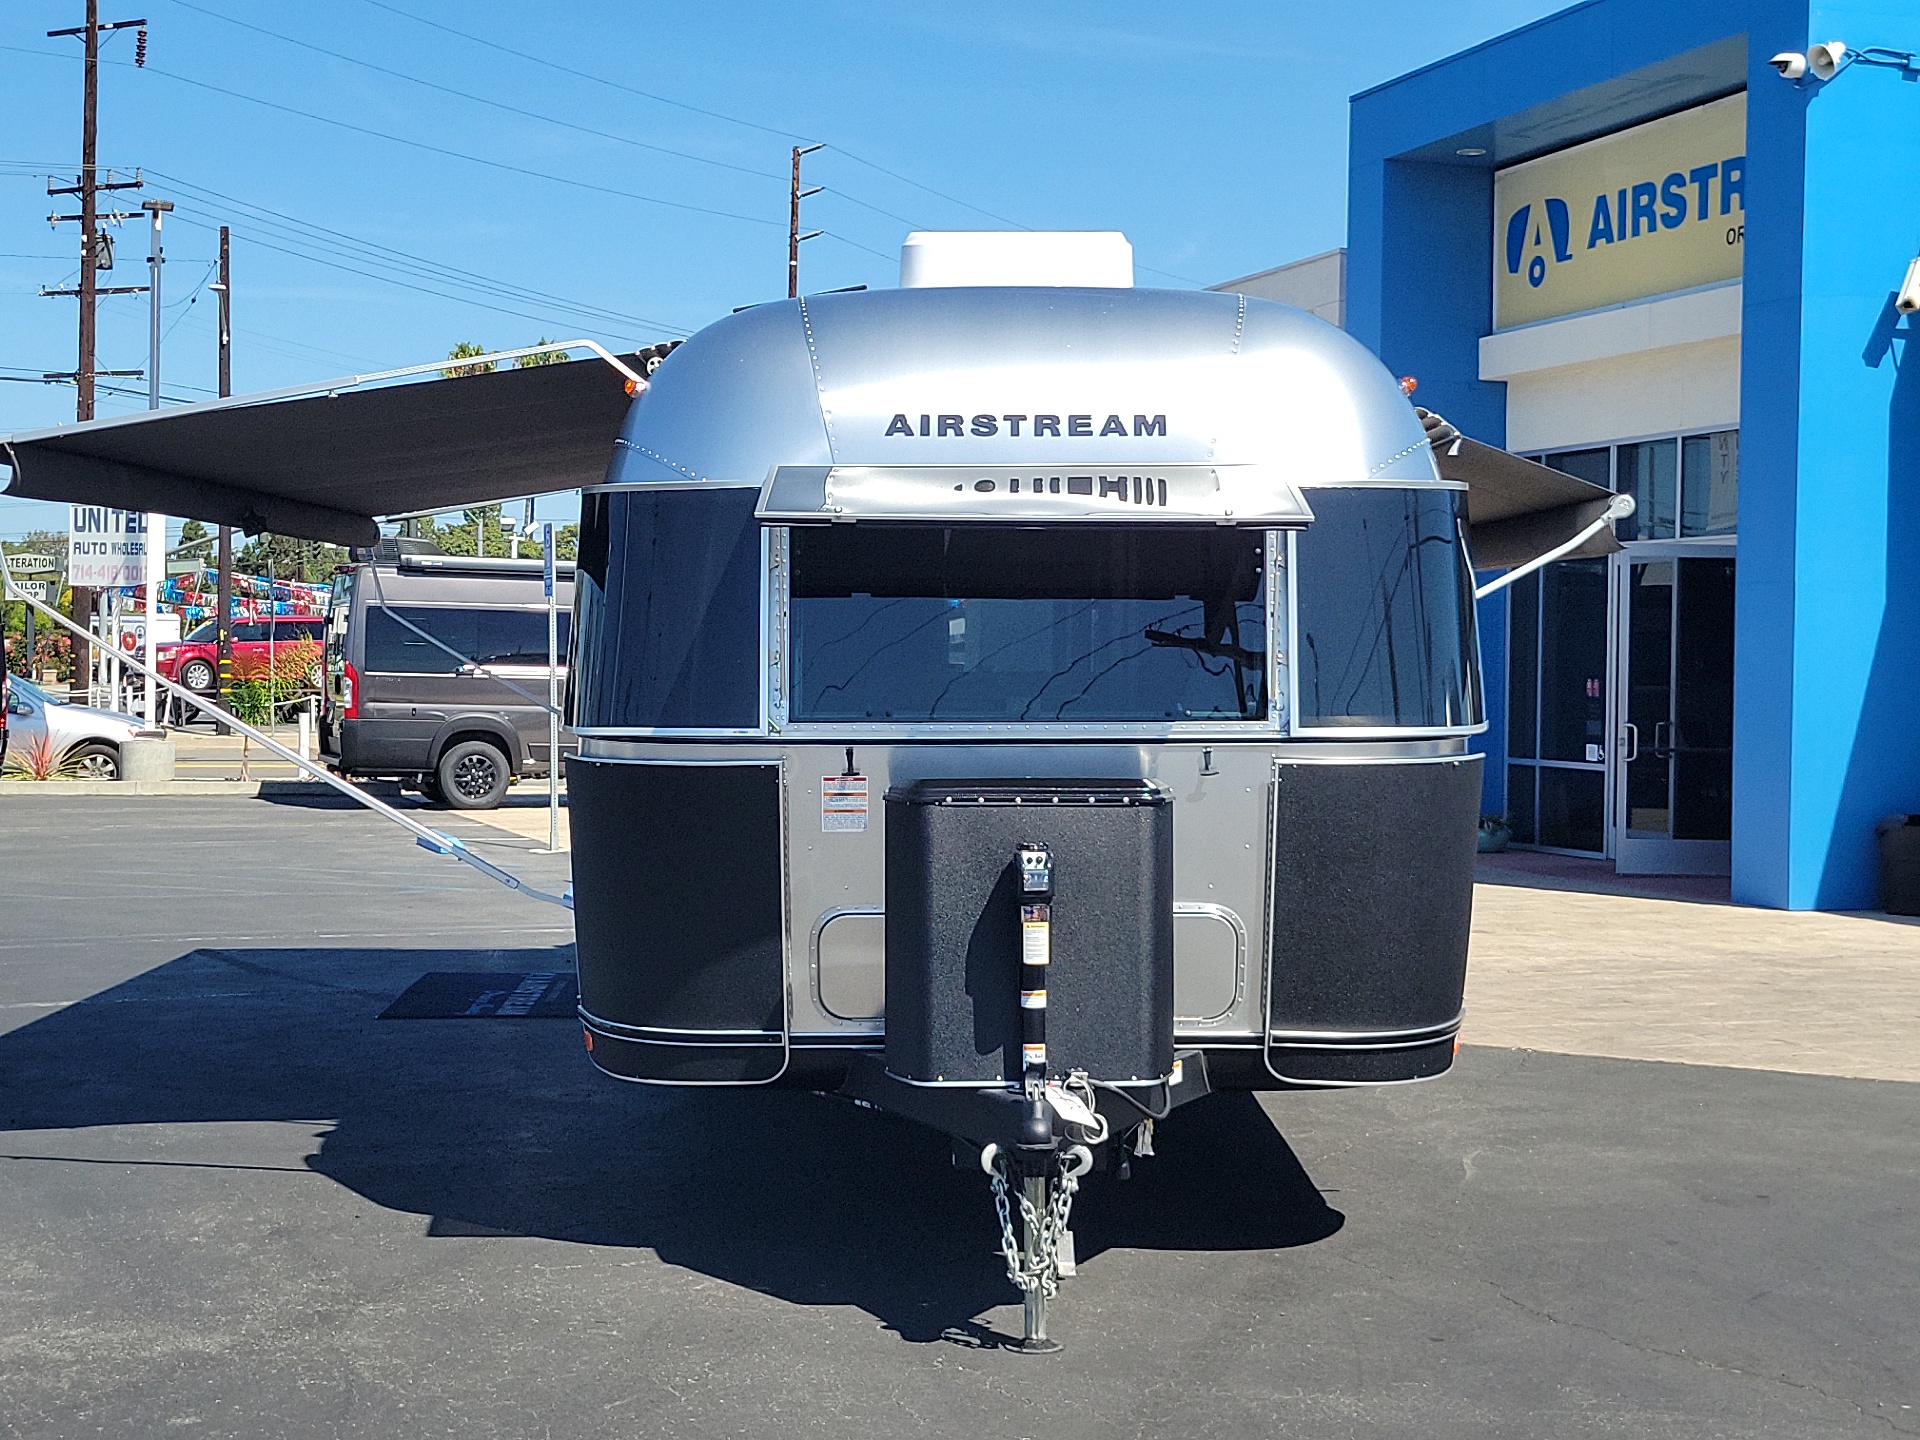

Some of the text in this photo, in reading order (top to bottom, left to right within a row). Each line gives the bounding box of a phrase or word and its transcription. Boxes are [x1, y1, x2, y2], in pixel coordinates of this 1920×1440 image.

[885, 414, 1167, 437] AIRSTREAM
[73, 541, 107, 555] AUTO
[7, 557, 55, 568] TERATION
